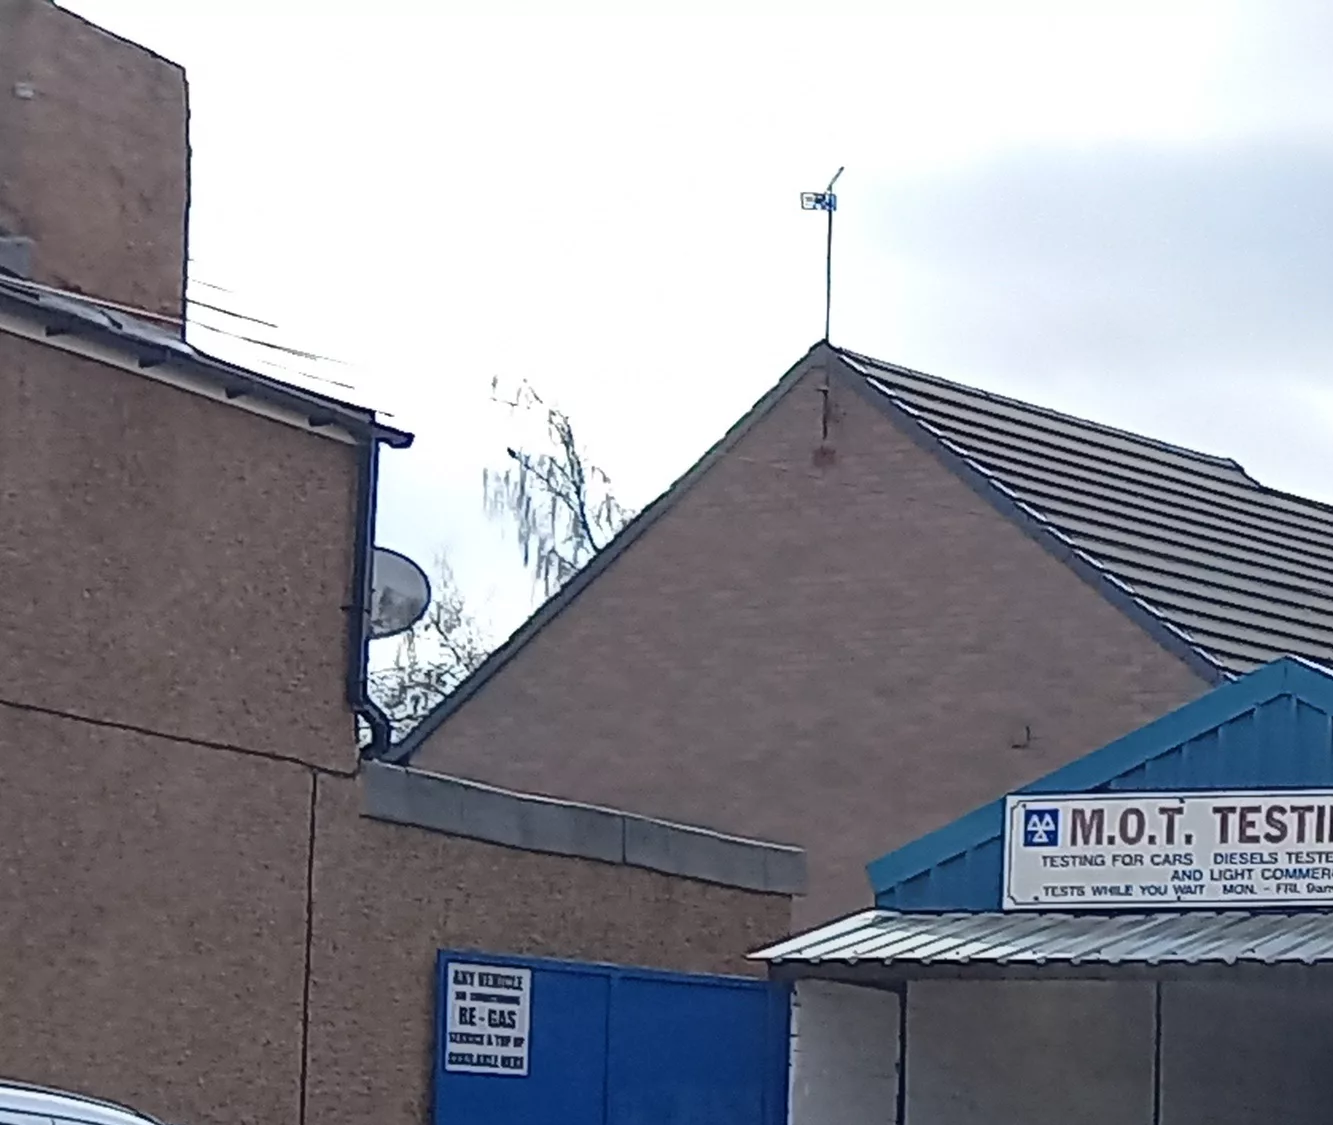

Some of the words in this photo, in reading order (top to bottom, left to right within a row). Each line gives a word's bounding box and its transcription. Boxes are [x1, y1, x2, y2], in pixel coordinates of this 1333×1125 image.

[1070, 806, 1193, 847] M.O.T.
[1042, 854, 1106, 868] TESTING
[1112, 853, 1144, 866] FOR
[1150, 853, 1194, 866] CARS
[1213, 852, 1278, 865] DIESELS
[1170, 869, 1204, 882] AND
[1209, 868, 1254, 881] LIGHT
[1043, 885, 1085, 897] TESTS
[1091, 885, 1133, 897] WHILE
[1139, 884, 1168, 896] YOU
[1173, 884, 1205, 896] WAIT
[488, 1008, 517, 1029] GAS
